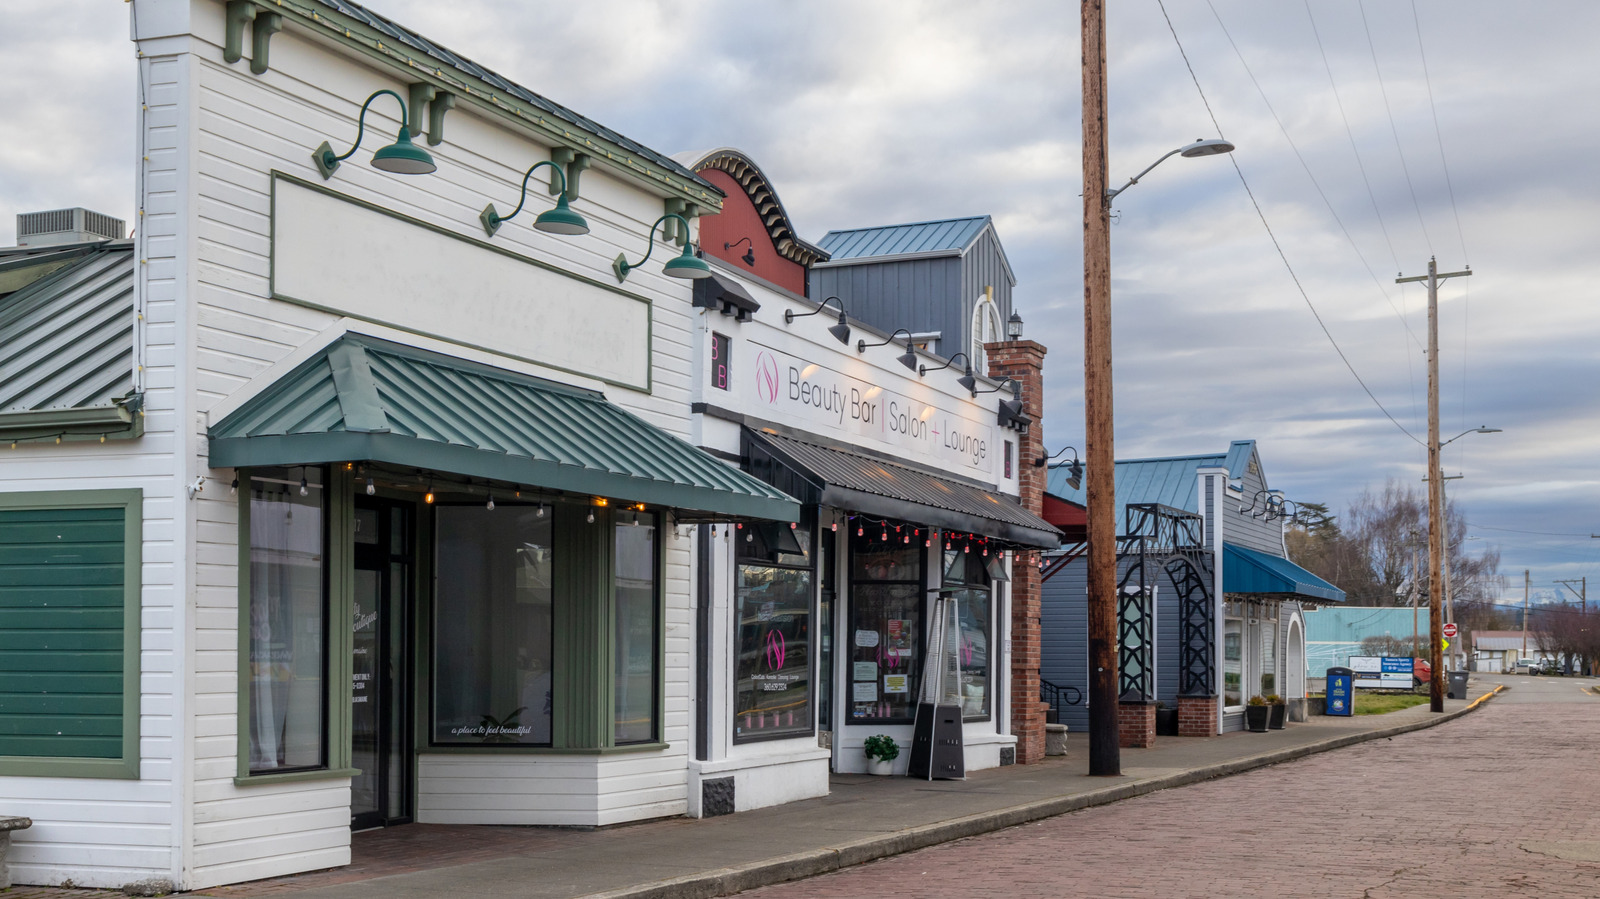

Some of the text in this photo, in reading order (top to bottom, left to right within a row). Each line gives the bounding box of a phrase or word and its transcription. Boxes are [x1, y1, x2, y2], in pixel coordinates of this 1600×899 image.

[789, 365, 847, 425] Beauty
[851, 387, 876, 425] Bar
[889, 401, 927, 441] Salon
[944, 419, 986, 466] Lounge
[456, 725, 478, 736] place
[478, 725, 486, 734] to
[485, 725, 500, 736] feel
[499, 725, 532, 737] beautiful
